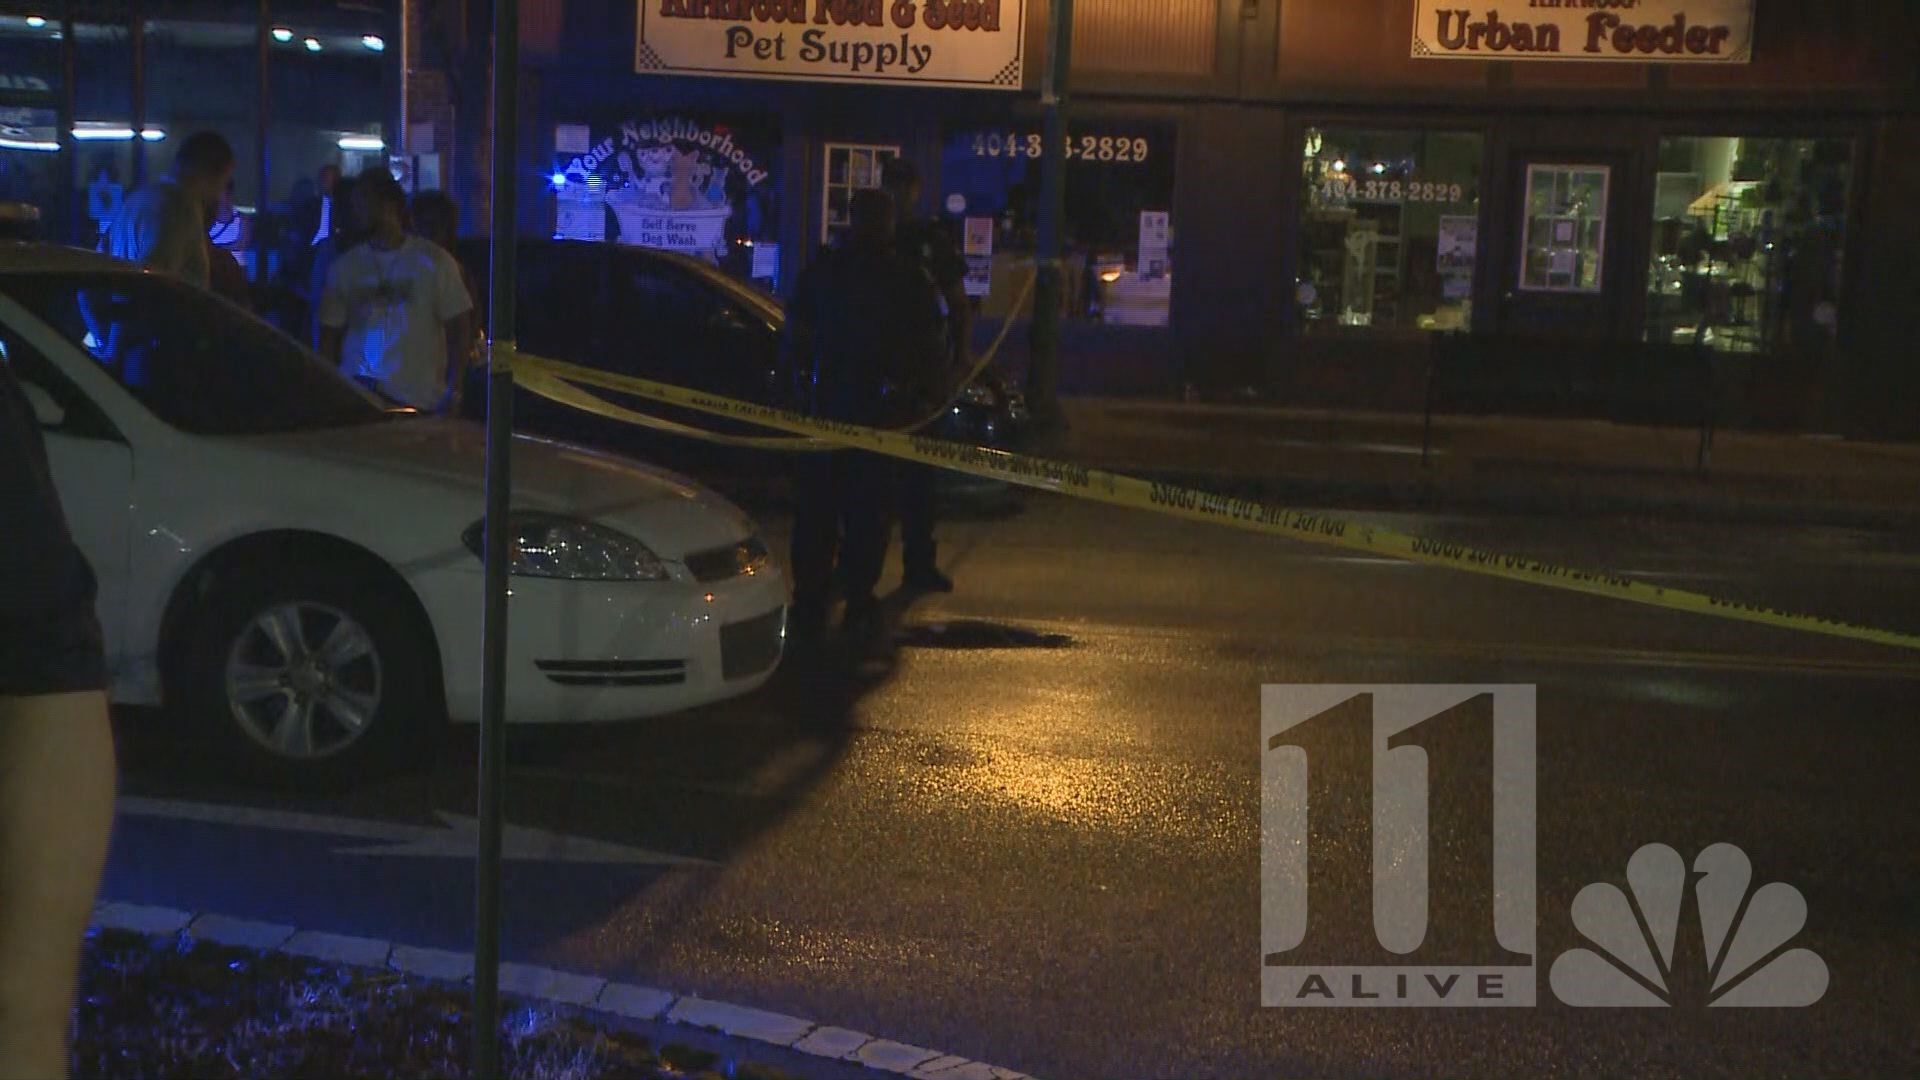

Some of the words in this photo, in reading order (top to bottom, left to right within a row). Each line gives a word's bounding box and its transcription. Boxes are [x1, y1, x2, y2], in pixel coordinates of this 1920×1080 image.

[725, 26, 785, 59] Pet
[800, 29, 931, 73] Supply
[1436, 9, 1560, 51] Urban
[1584, 11, 1729, 54] Feeder
[620, 114, 768, 187] Neighborhood
[972, 131, 1148, 163] 404-3-2829
[1321, 179, 1462, 202] 404-378-2829
